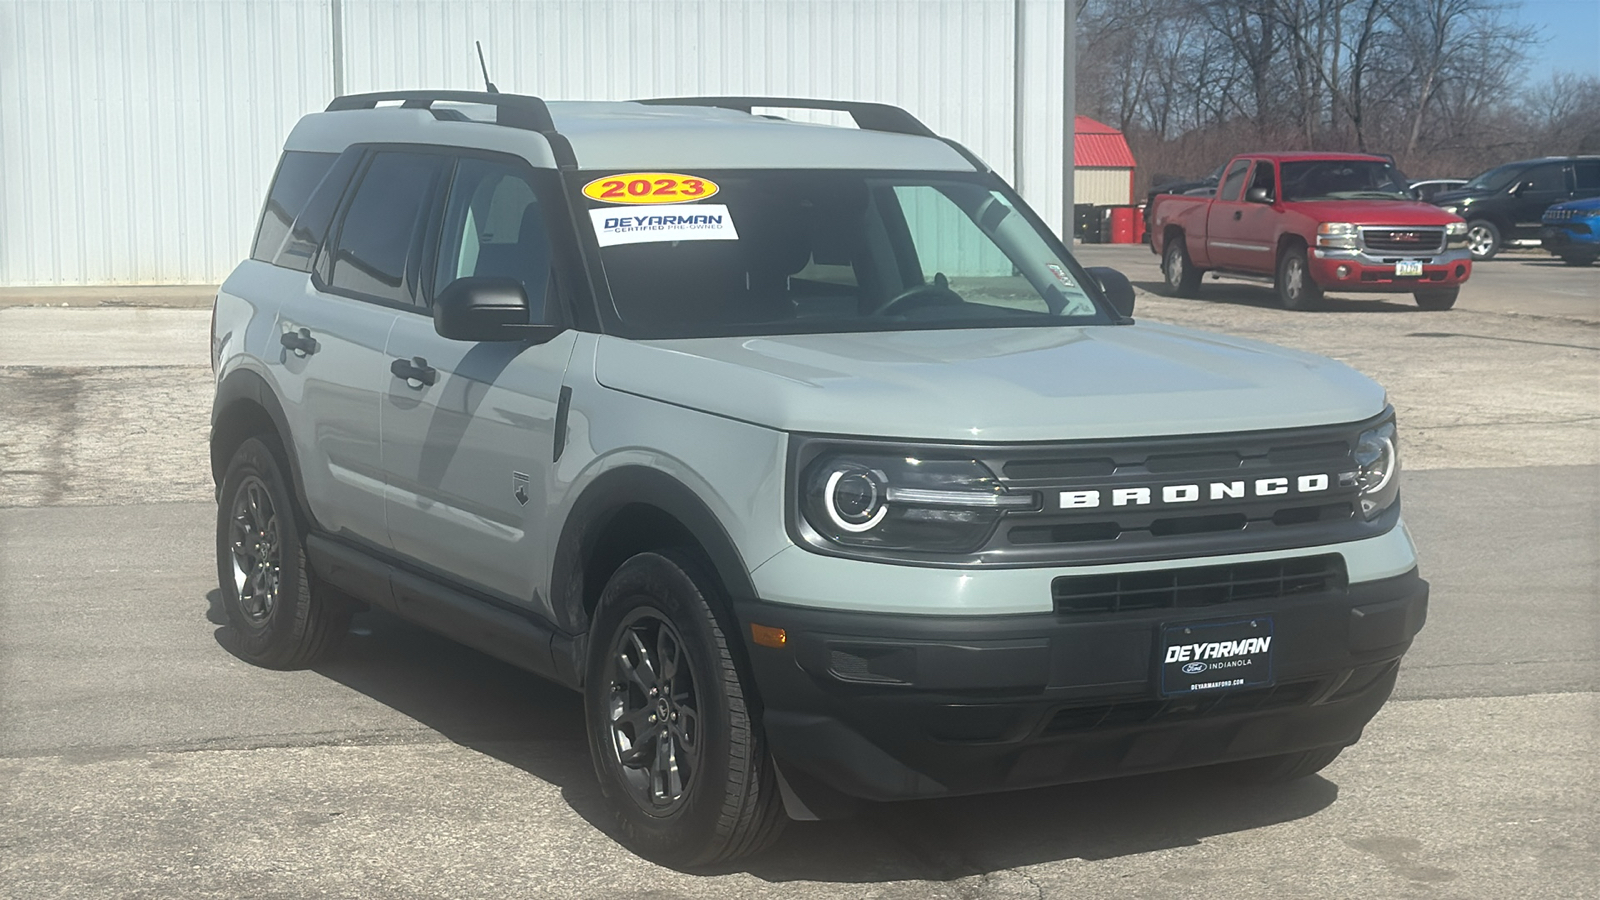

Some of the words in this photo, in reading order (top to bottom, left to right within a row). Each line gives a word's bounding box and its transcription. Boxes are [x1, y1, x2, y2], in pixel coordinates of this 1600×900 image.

[600, 179, 706, 198] 2023
[604, 215, 723, 229] DEYARMAN
[1059, 473, 1329, 509] BRONCO
[1164, 636, 1272, 664] DEYARMAN
[1209, 659, 1252, 670] INDIANOLA
[1190, 679, 1245, 691] DEYARMANFORD.COM
